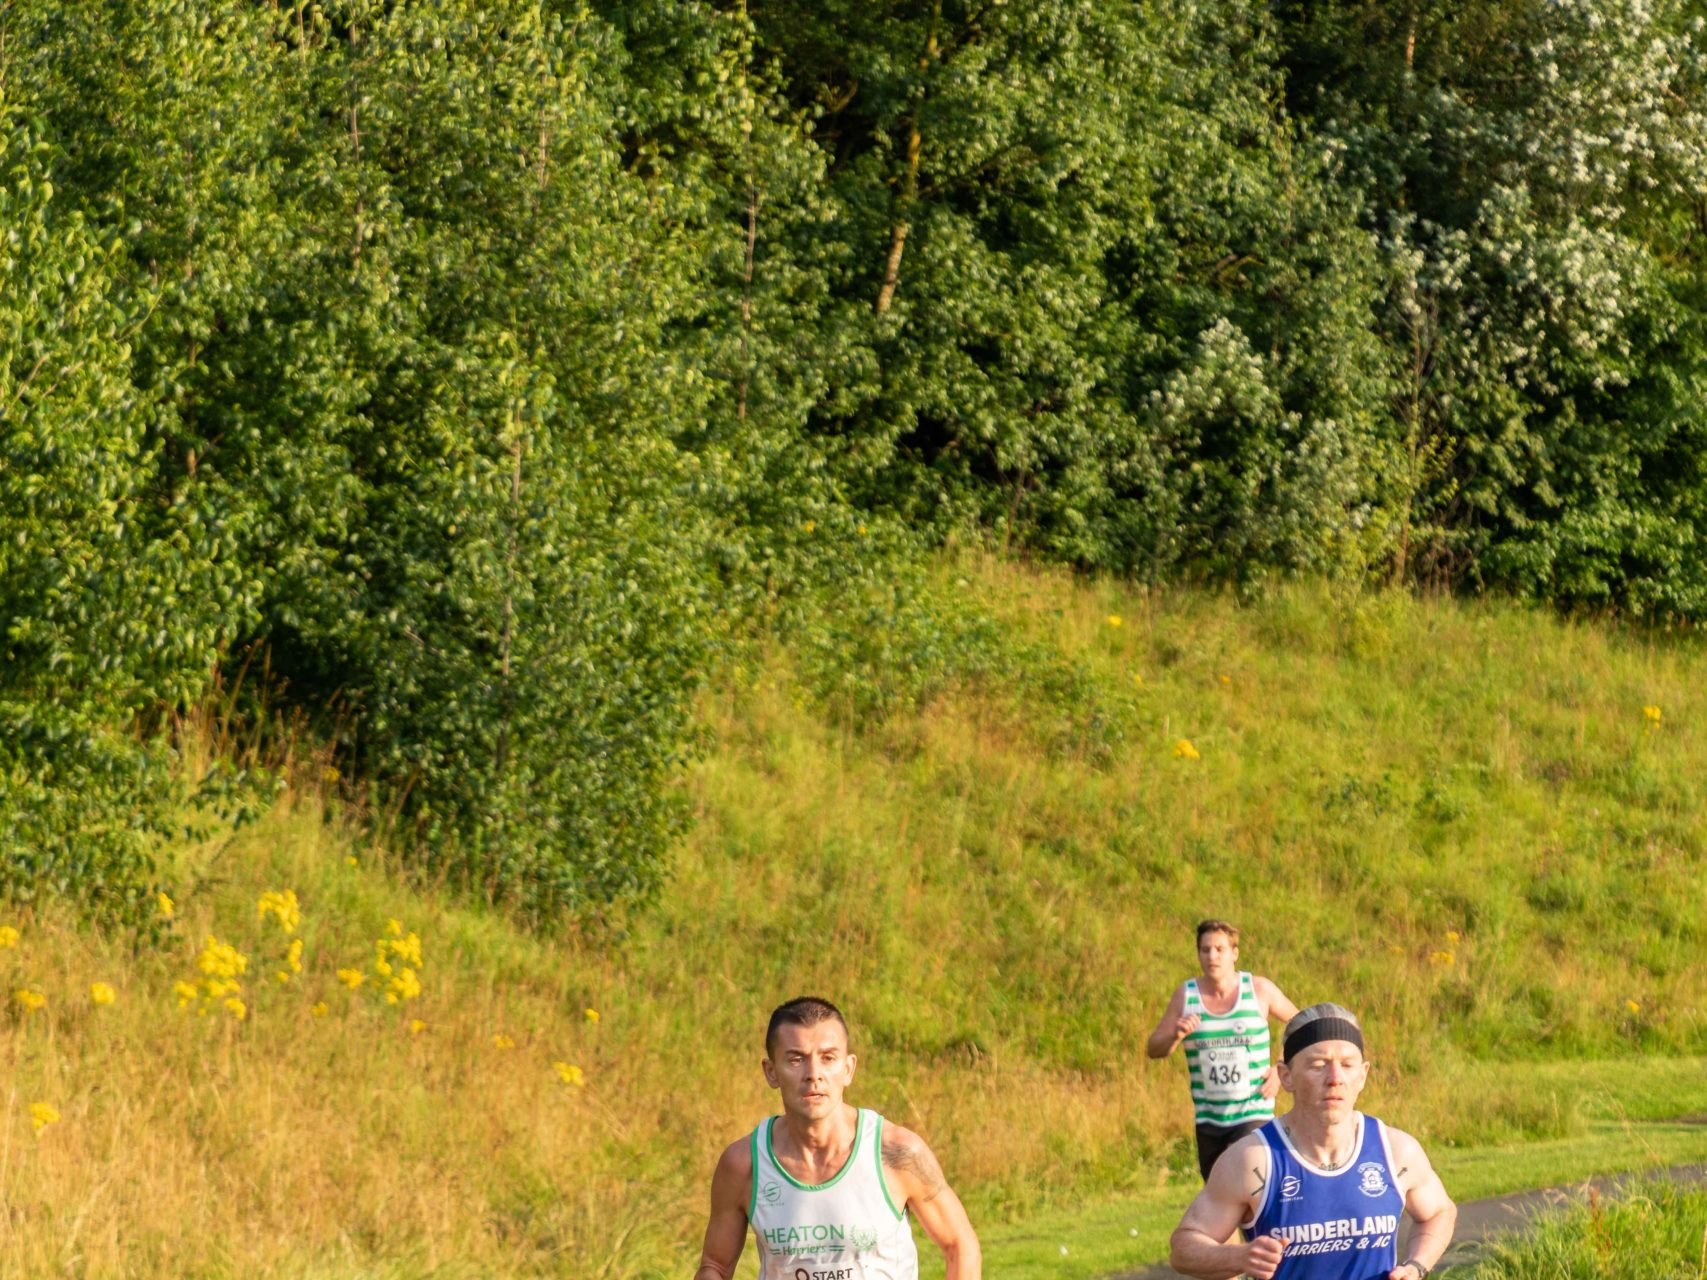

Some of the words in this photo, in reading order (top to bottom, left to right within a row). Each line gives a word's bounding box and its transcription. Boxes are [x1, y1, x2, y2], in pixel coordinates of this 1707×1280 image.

[1209, 1064, 1241, 1085] 436
[763, 1224, 845, 1244] HEATON
[1270, 1215, 1397, 1244] SUNDERLAND
[783, 1244, 827, 1256] Harriers
[1356, 1237, 1369, 1250] &
[1371, 1235, 1392, 1248] AC
